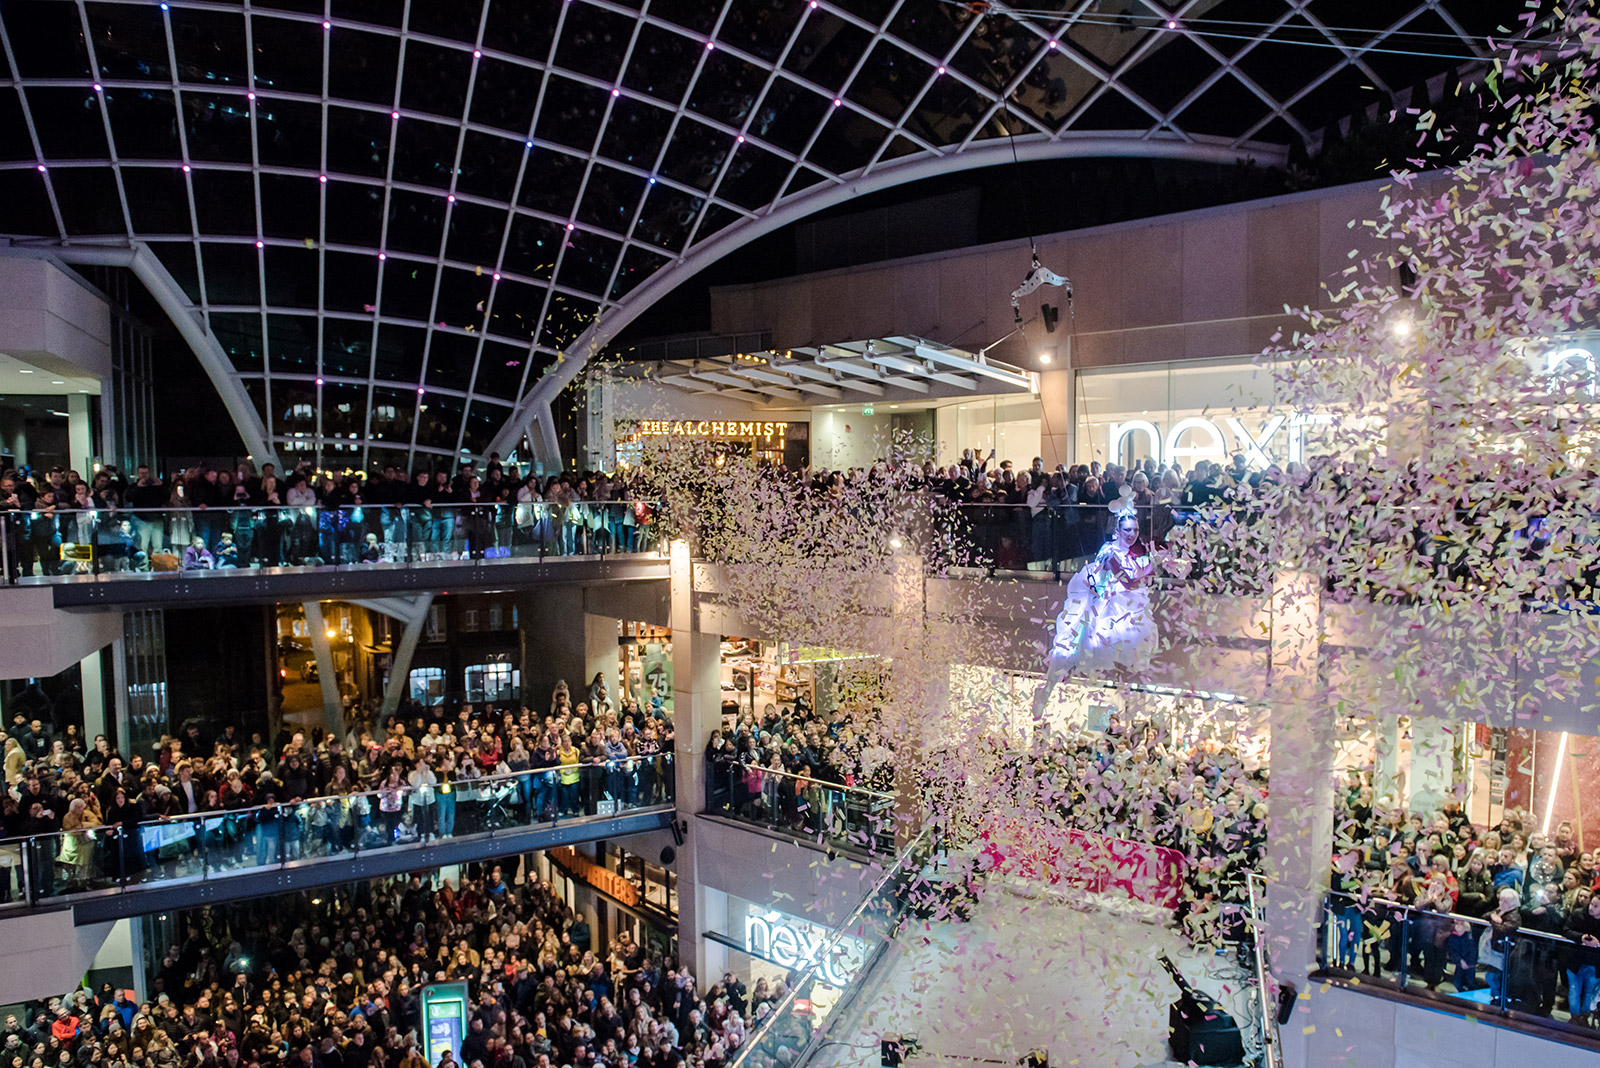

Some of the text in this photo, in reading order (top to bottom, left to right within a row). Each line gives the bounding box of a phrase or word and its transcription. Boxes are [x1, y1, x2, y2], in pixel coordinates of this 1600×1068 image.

[642, 421, 788, 436] THE ALCHEMIST
[636, 621, 673, 645] UR
[648, 673, 668, 696] 75
[745, 915, 847, 987] next
